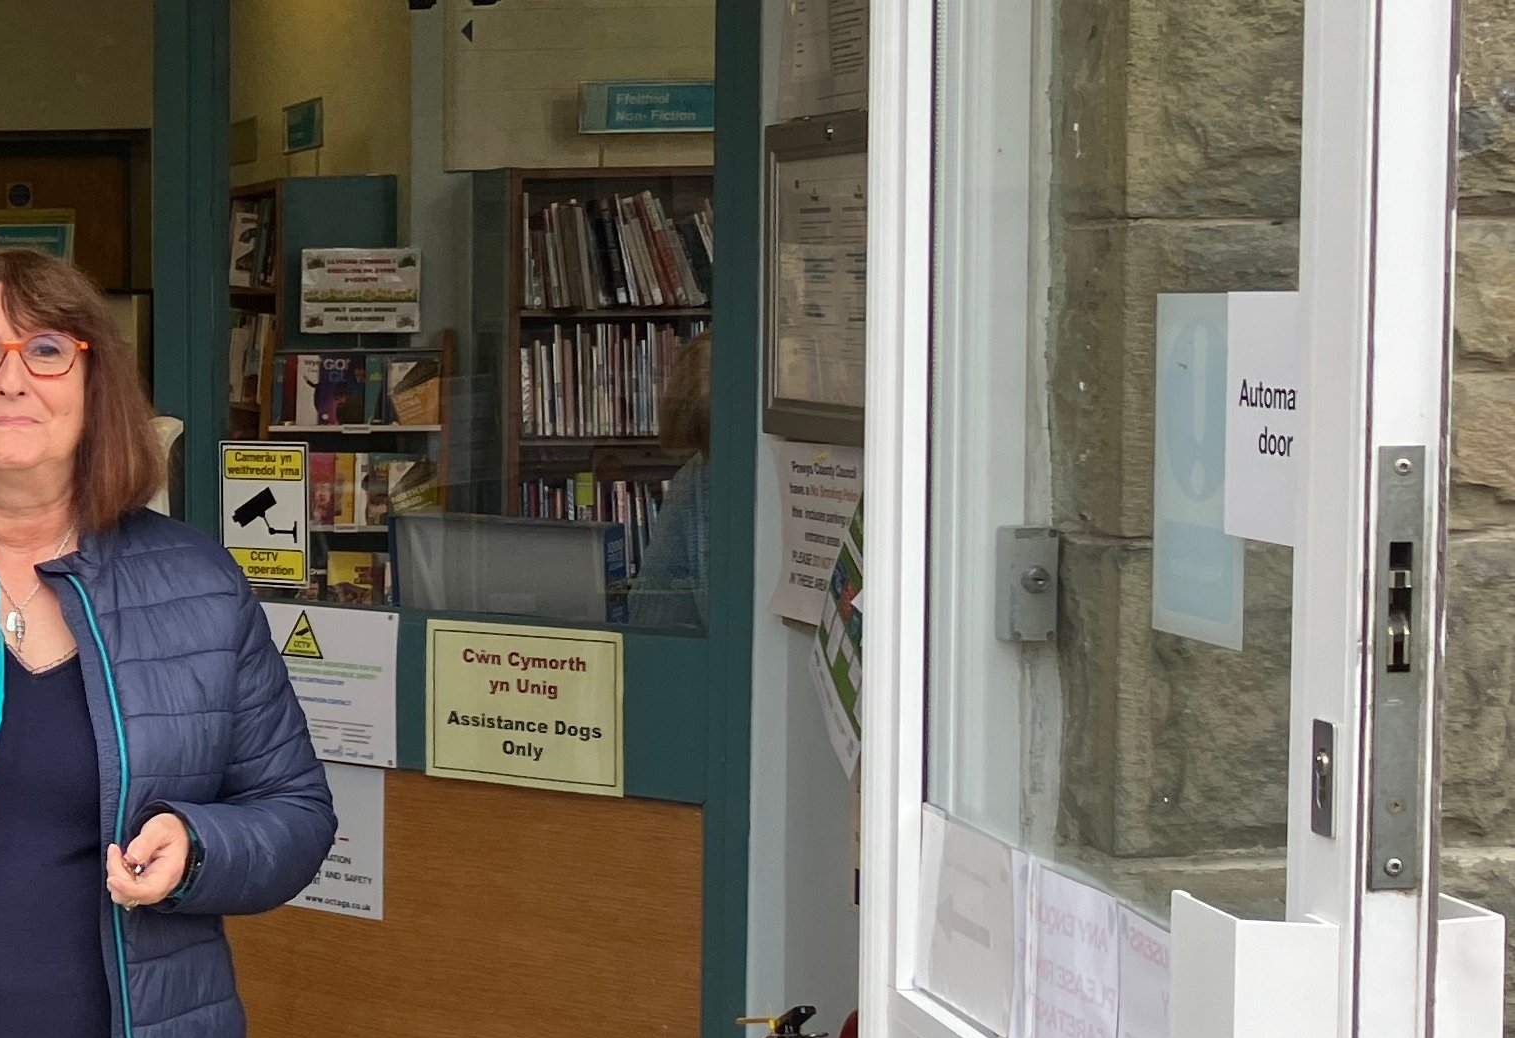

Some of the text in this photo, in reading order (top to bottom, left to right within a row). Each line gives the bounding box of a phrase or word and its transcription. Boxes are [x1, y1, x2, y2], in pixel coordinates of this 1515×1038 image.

[651, 110, 697, 121] Fiction
[1239, 379, 1296, 411] Automa
[1259, 426, 1293, 457] door
[280, 455, 292, 465] yn
[228, 465, 300, 478] weithredol yma
[814, 463, 835, 479] County
[250, 551, 279, 562] CCTV
[248, 565, 295, 578] operation
[293, 640, 312, 649] CCTV
[508, 651, 587, 672] Cymorth
[489, 678, 558, 699] yn Unig
[447, 710, 603, 742] Assistance Dogs
[502, 740, 544, 761] Only
[325, 871, 373, 885] AND SAFETY
